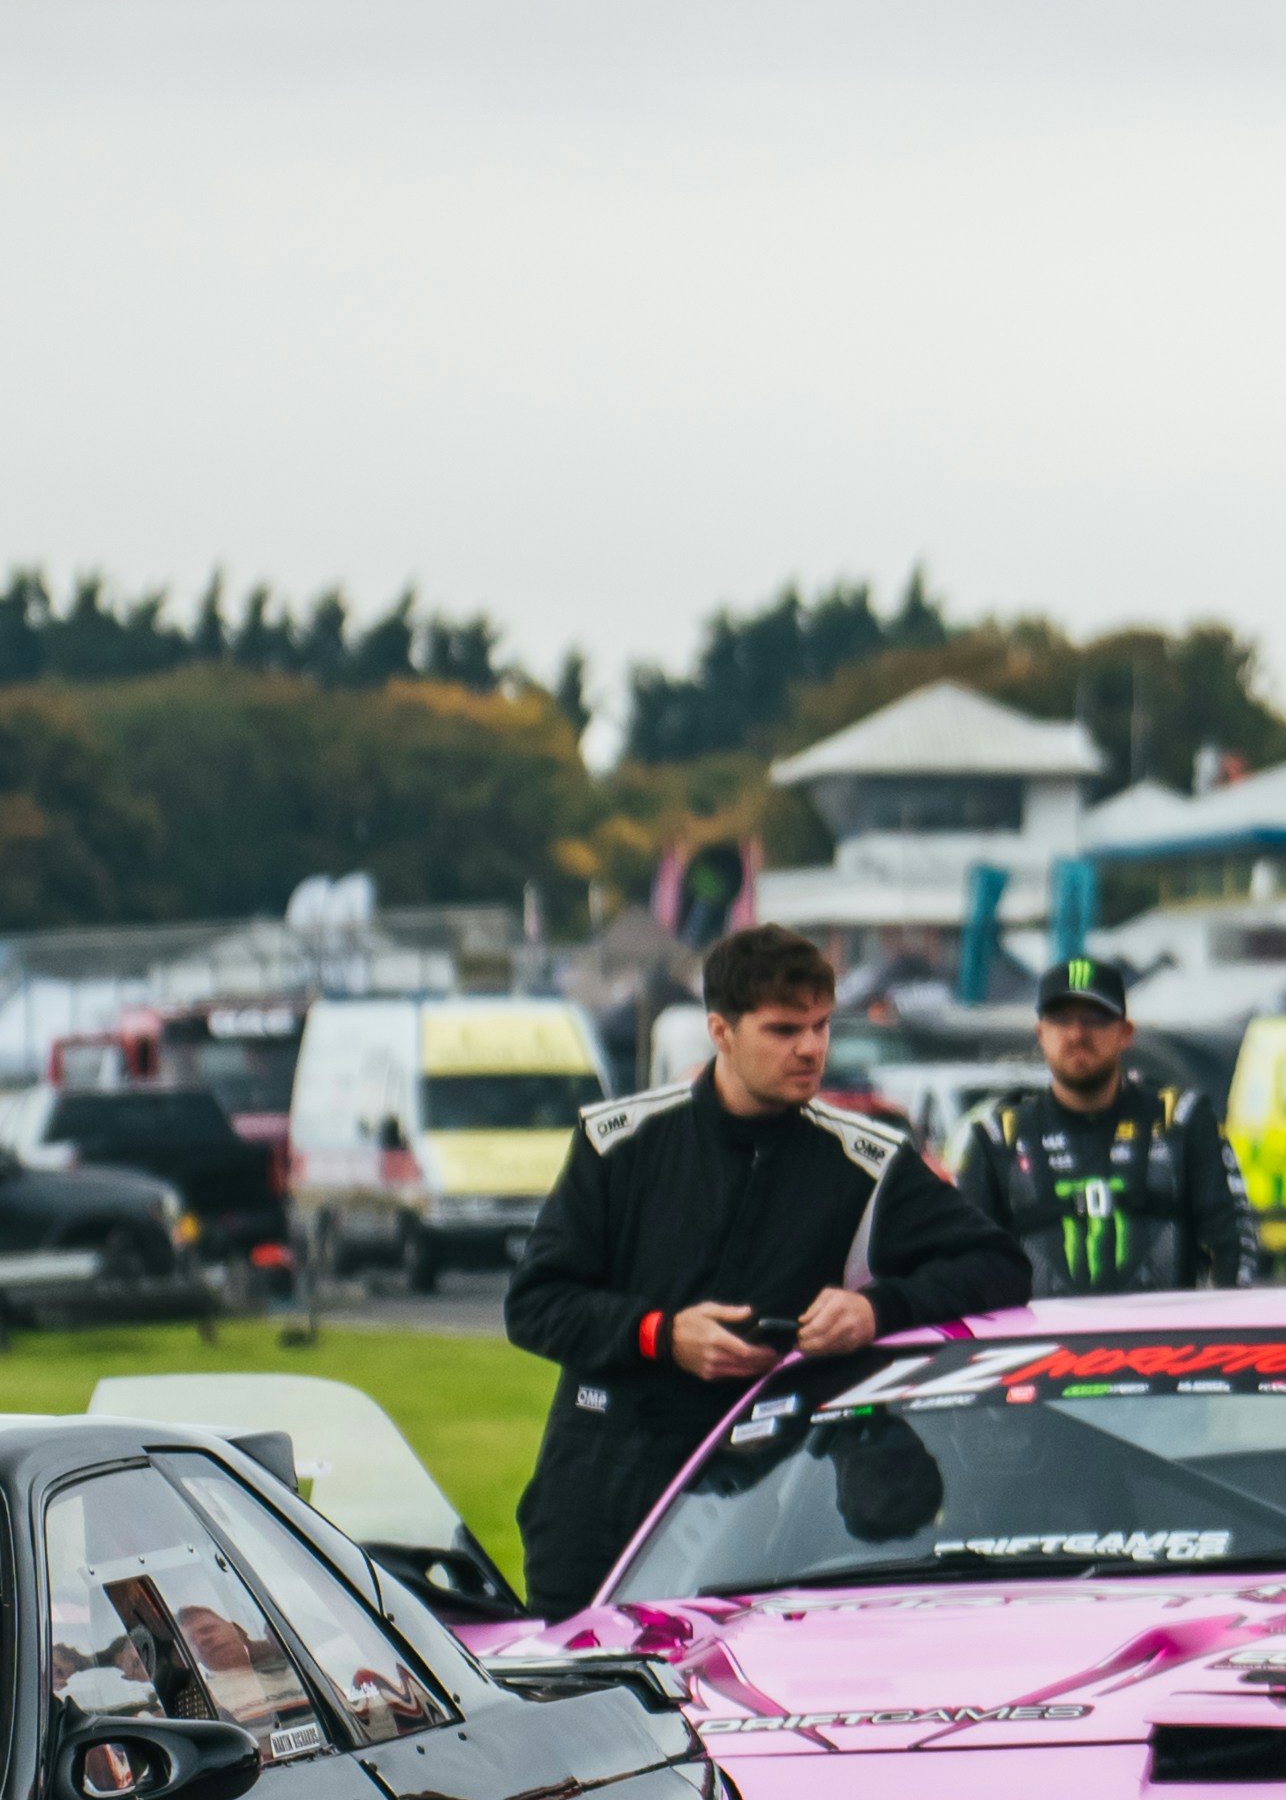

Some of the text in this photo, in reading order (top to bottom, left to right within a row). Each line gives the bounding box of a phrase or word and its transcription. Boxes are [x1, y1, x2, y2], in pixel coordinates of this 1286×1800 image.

[596, 1113, 630, 1136] OMP
[853, 1138, 886, 1162] OMP
[576, 1386, 608, 1410] OMP
[698, 1703, 1087, 1734] DRIFTGAMES
